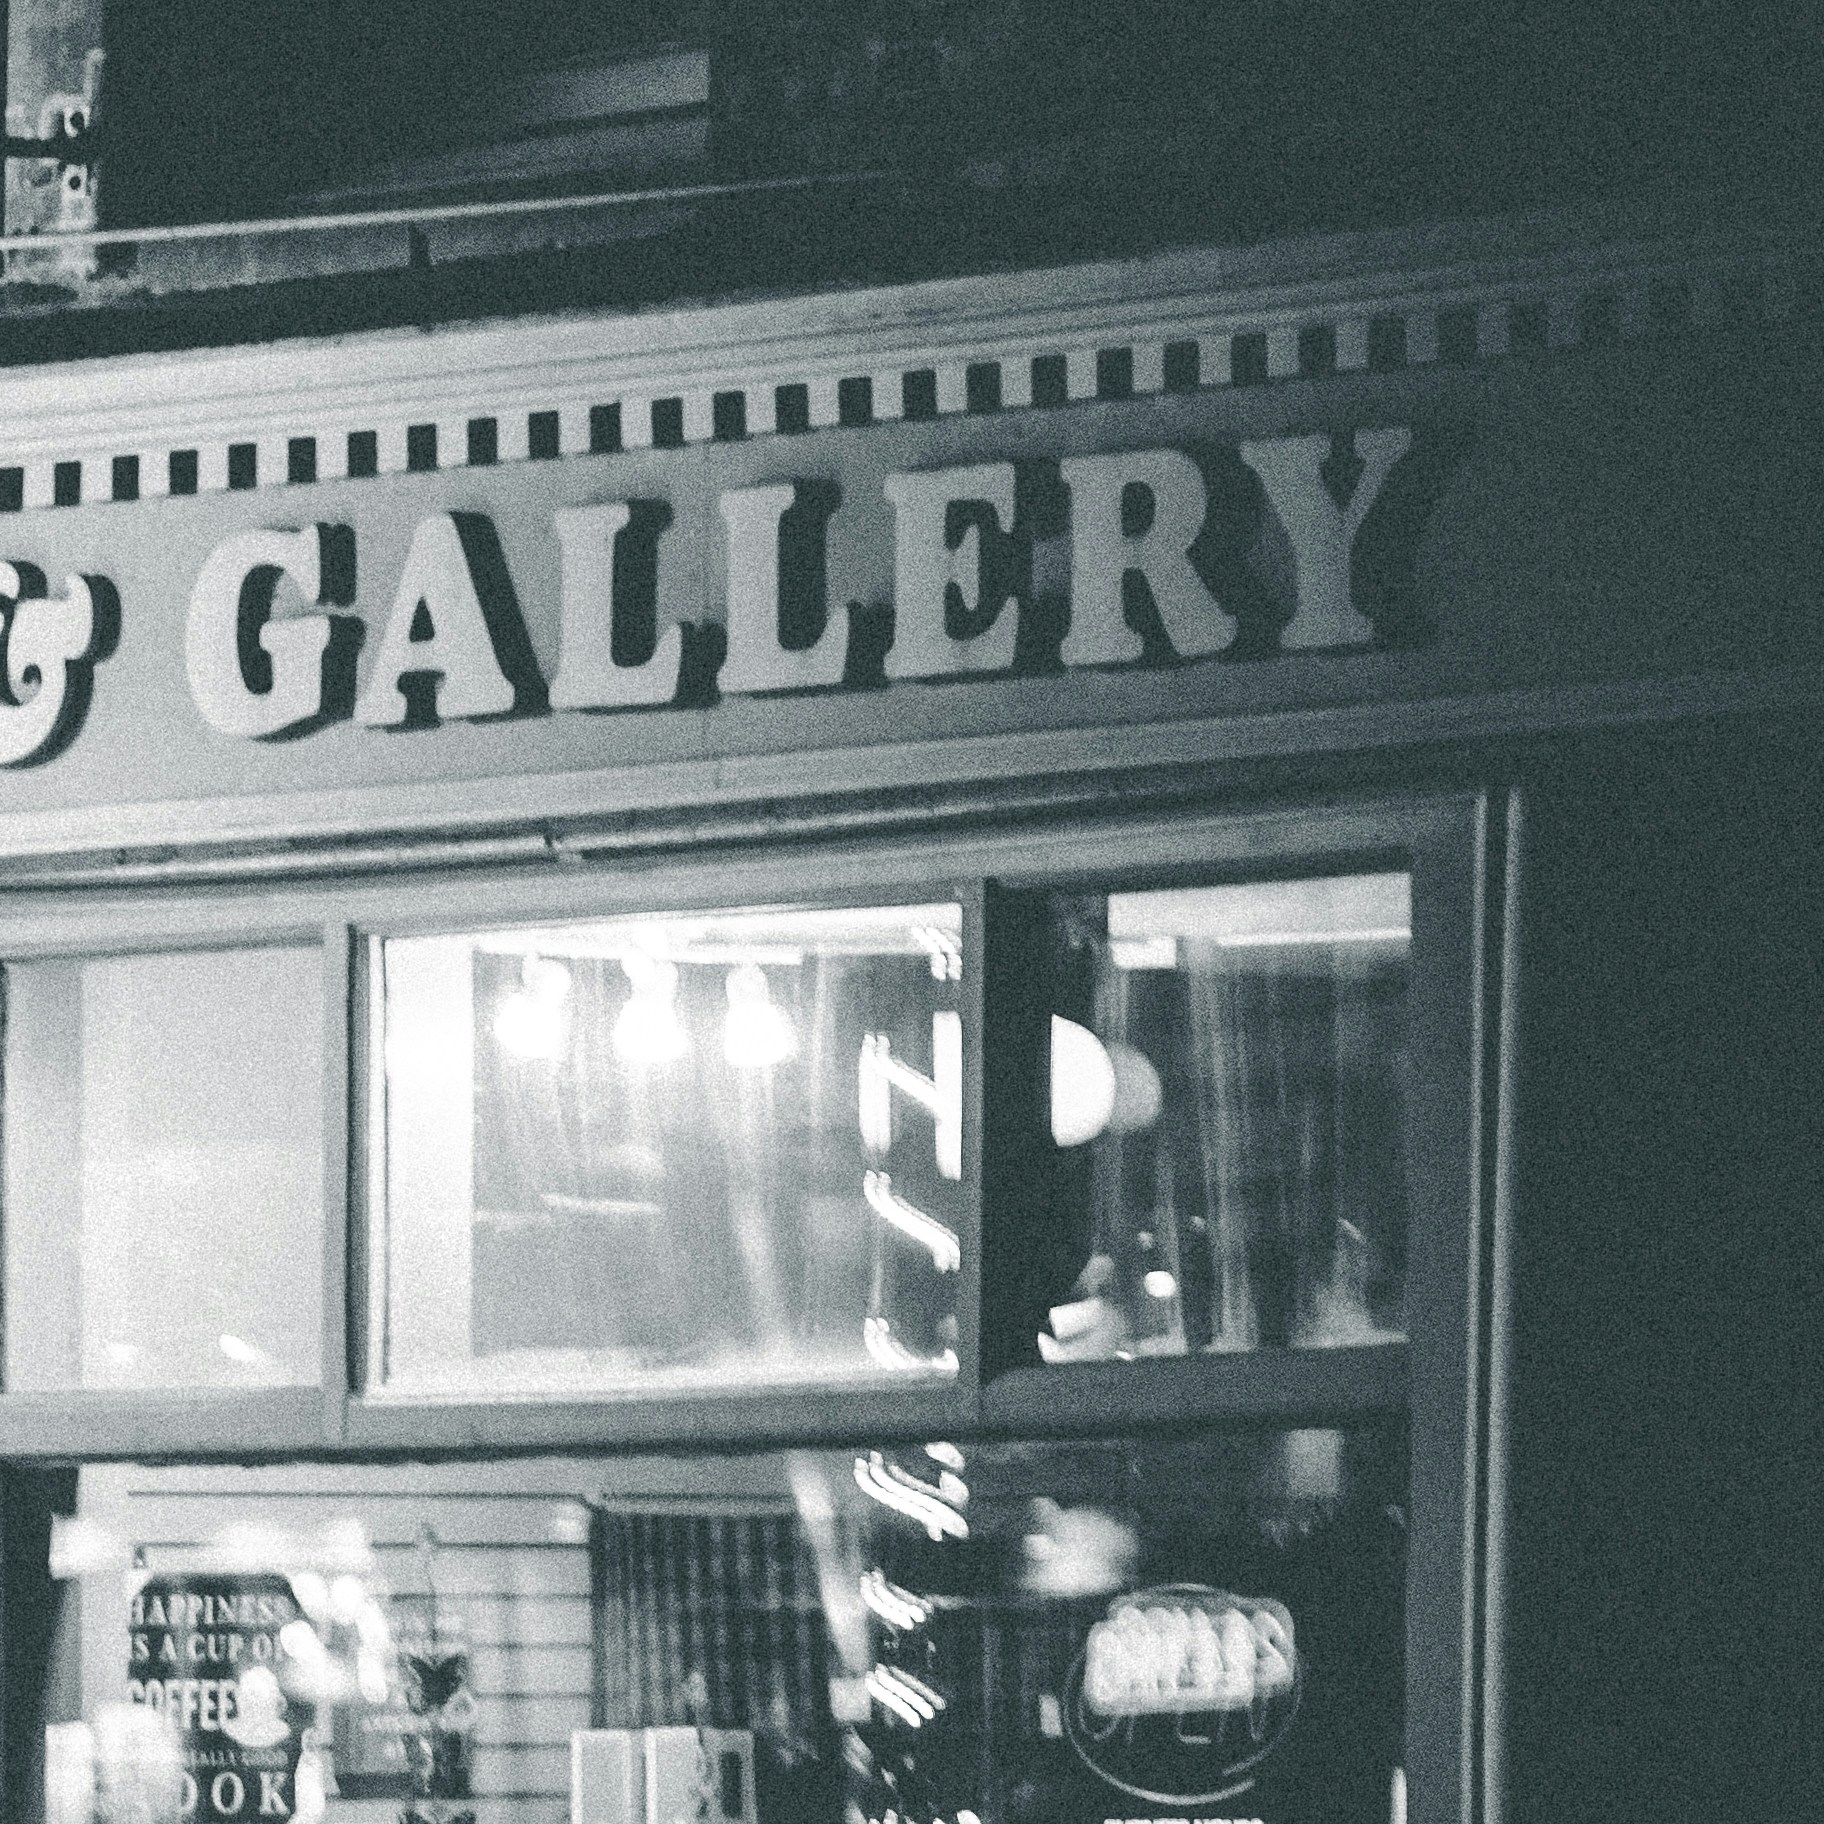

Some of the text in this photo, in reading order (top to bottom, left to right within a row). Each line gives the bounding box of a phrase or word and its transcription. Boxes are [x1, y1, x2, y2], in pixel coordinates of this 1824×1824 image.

[186, 430, 1414, 742] GALLERY
[159, 1633, 178, 1661] A
[187, 1634, 245, 1661] CUP
